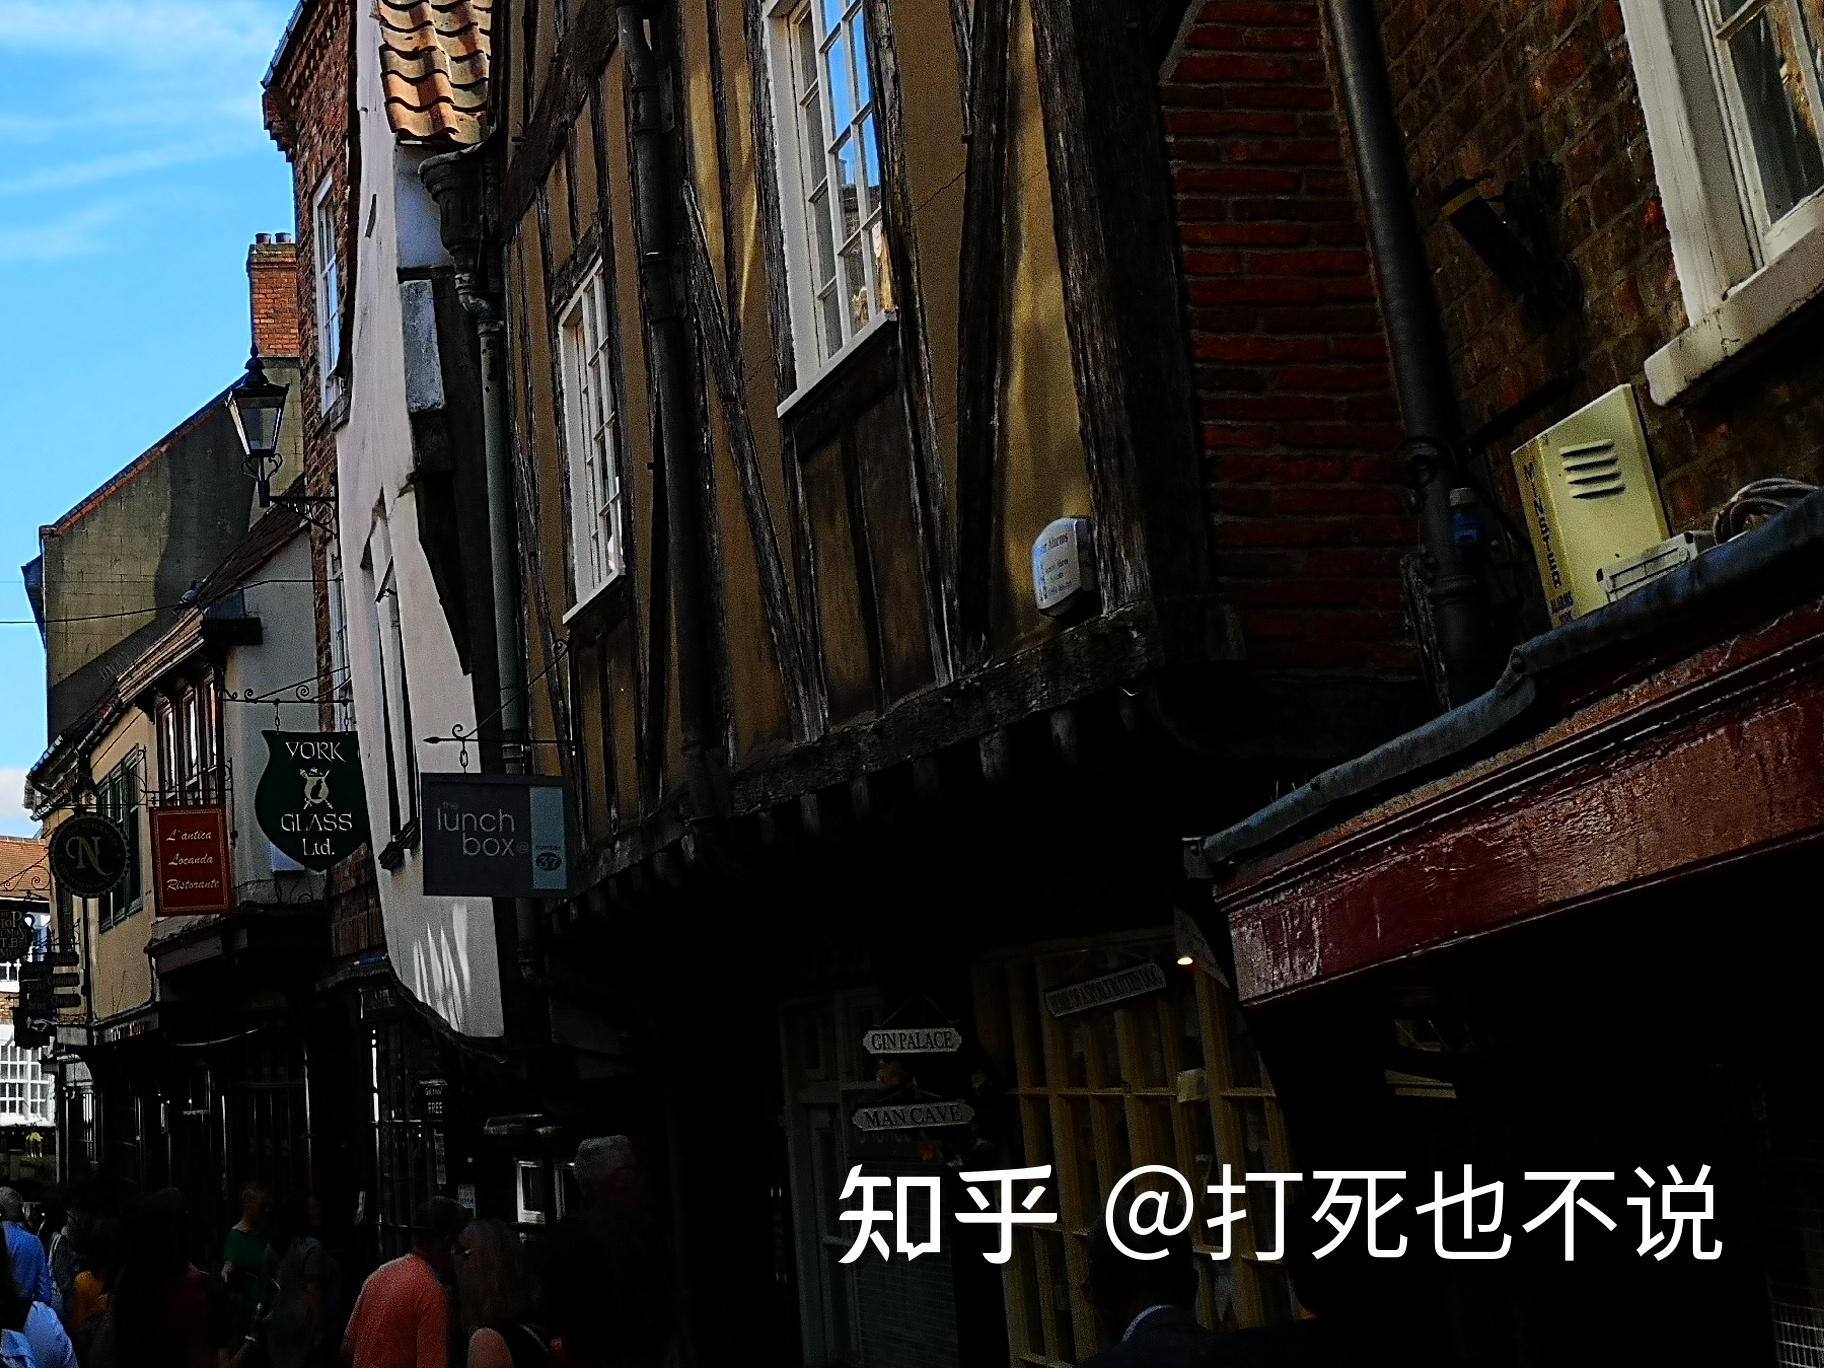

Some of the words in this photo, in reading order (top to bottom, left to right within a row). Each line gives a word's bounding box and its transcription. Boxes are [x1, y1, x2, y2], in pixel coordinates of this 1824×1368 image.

[285, 741, 347, 763] YORK
[280, 812, 353, 833] GLASS
[437, 807, 515, 832] lunch
[302, 838, 336, 856] Ltd.
[462, 832, 515, 857] box
[167, 853, 214, 866] Locanda
[165, 878, 220, 891] Ristorante
[871, 1032, 896, 1050] GIN
[899, 1031, 954, 1049] PALACE
[864, 1110, 905, 1127] MAN
[910, 1104, 963, 1124] CAVE
